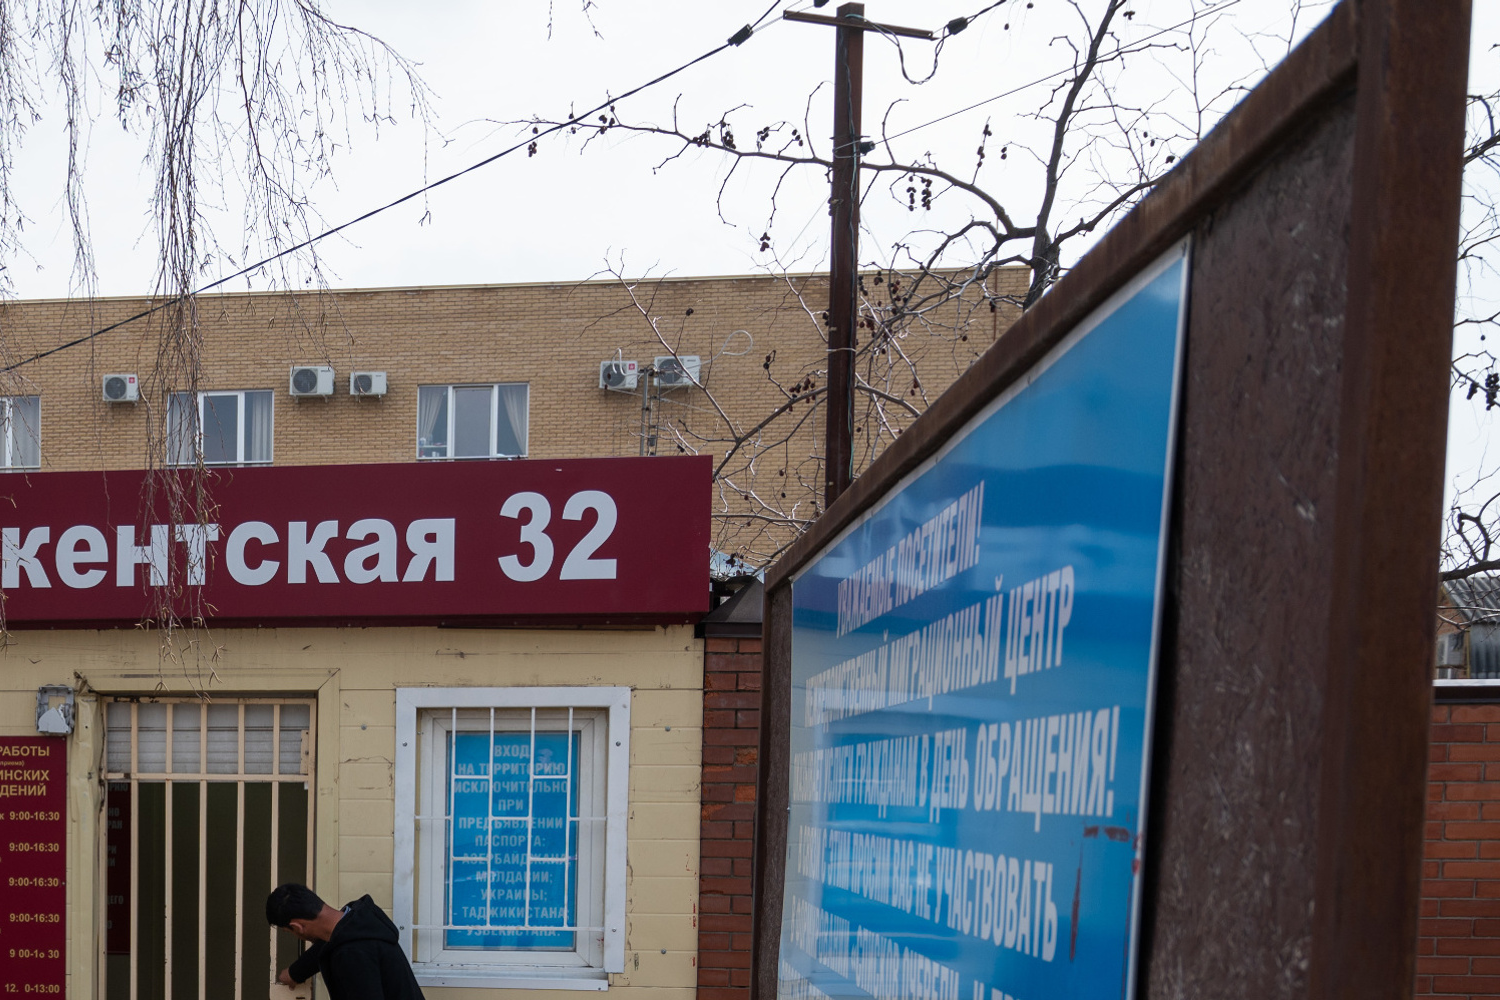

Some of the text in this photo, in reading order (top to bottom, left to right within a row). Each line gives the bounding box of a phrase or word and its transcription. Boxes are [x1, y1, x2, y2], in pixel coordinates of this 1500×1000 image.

[497, 490, 618, 583] 32
[836, 480, 985, 639] УВАЖАЕМЫЕ ПОСЕТИТЕЛИ!
[887, 565, 1075, 711] МИГРАЦИОННЫЙ ЦЕНТР
[494, 744, 530, 759] ВХОД
[457, 763, 475, 775] НА
[823, 744, 854, 804] УСЛУГИ
[854, 735, 919, 819] ГРАЖДАНАМ
[919, 734, 929, 807] В
[929, 727, 969, 824] ДЕНЬ
[974, 706, 1120, 833] ОБРАЩЕНИЯ!
[498, 799, 524, 811] ПРИ
[9, 811, 60, 821] 9:00-16:30
[9, 842, 60, 852] 9:00-16:30
[8, 877, 59, 887] 9:00-16:30
[827, 829, 851, 892] ЭТИМ
[851, 832, 891, 905] ПРОСИМ
[891, 839, 914, 915] ВАС
[915, 842, 933, 921] НЕ
[934, 845, 1058, 963] УЧАСТВОВАТЬ
[9, 913, 60, 923] 9:00-16:30
